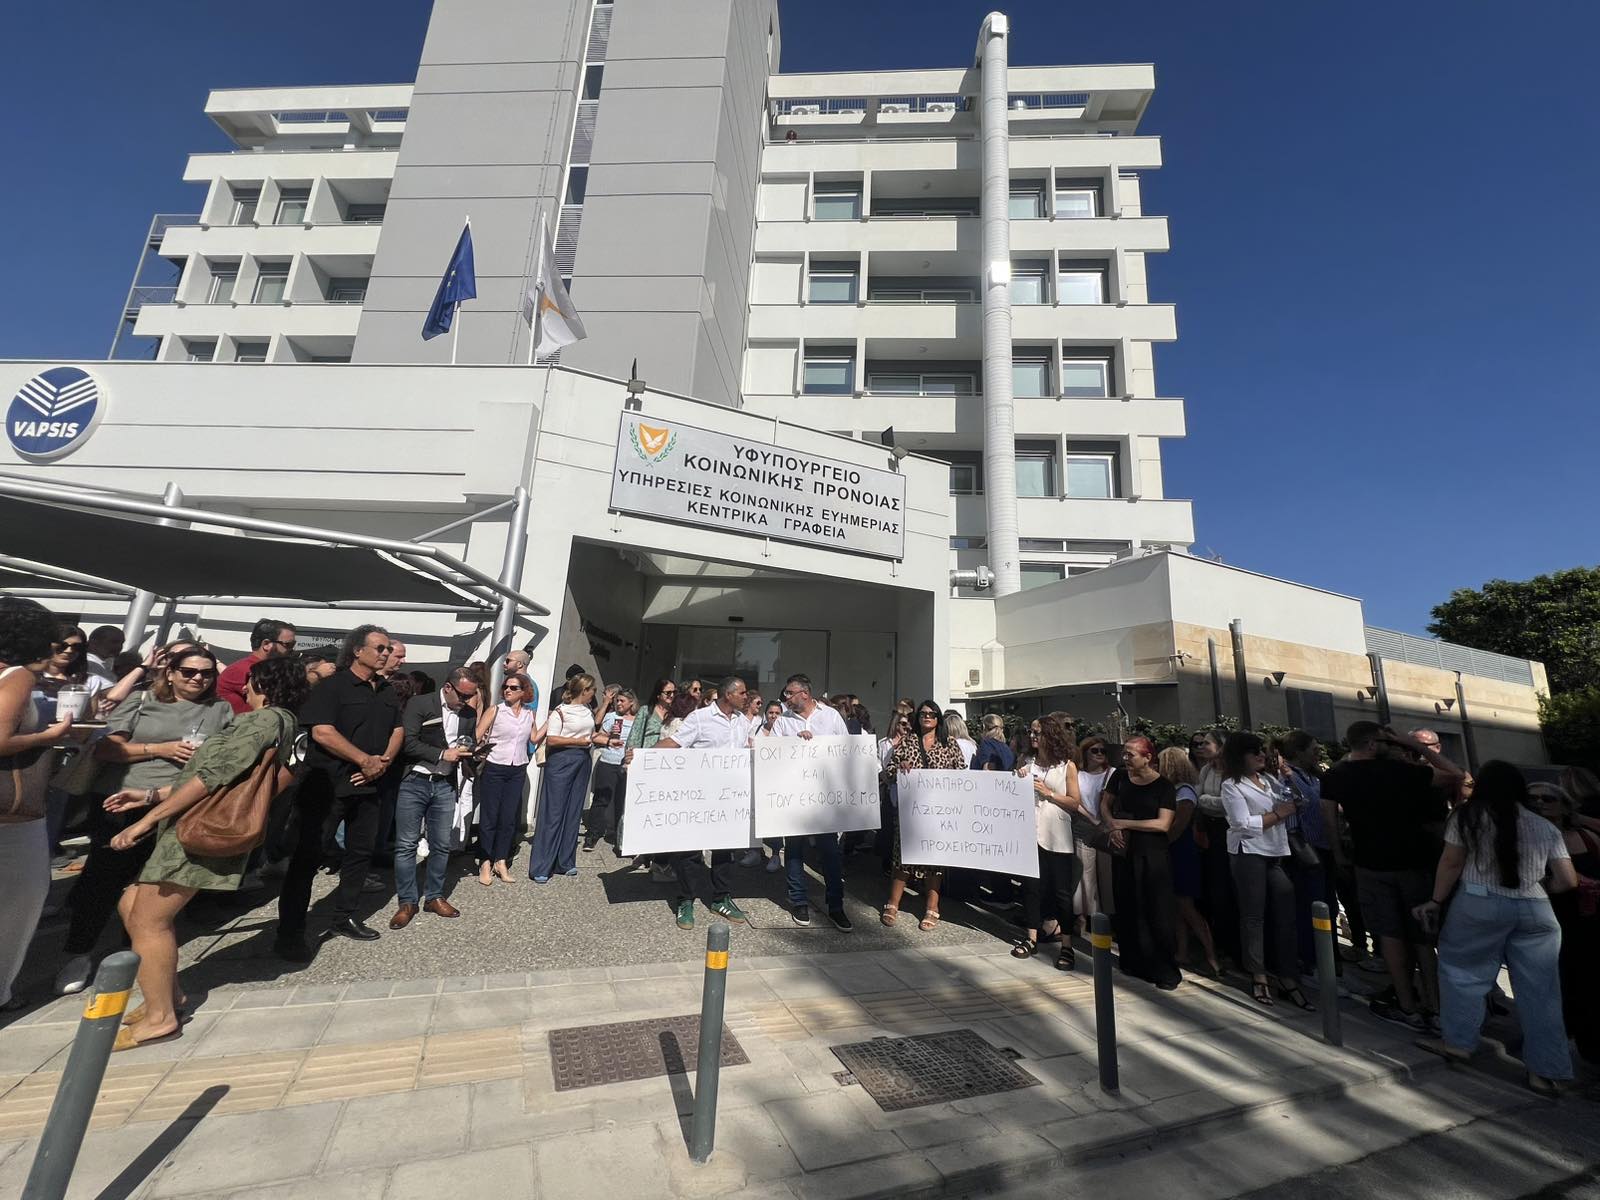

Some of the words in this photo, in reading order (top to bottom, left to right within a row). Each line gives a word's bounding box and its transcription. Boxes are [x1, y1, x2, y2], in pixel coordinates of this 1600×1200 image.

[14, 421, 79, 438] VAPSIS
[733, 444, 861, 485] ΥΦΥΠΟΥΡΓΕΙΟ
[684, 453, 804, 491] ΚΟΙΝΩΝΙΚΗΣ
[813, 480, 900, 512] ΠΡΟΝΟΙΑΣ
[618, 469, 713, 498] ΥΠΗΡΕΣΙΕΣ
[719, 488, 814, 518] ΚΟΙΝΩΝΙΚΗΣ
[821, 508, 900, 535] ΕΥΗΜΕΡΙΑΣ
[687, 500, 768, 526] ΚΕΝΤΡΙΚΑ
[784, 518, 846, 540] ΓΡΑΦΕΙΑ
[643, 751, 686, 771] ΕΔΩ
[760, 744, 782, 761] ΟΧΙ
[790, 744, 819, 760] ΣΤΙΣ
[802, 768, 826, 780] ΚΑΙ
[917, 772, 978, 792] ΑΝΑΠΗΡΟΙ
[994, 778, 1020, 796] ΜΑΣ
[633, 782, 706, 806] ΣΕΒΑΣΜΟΣ
[718, 786, 750, 801] ΣΤΗΝ
[766, 792, 794, 808] ΤΟΝ
[642, 808, 728, 829] ΑΞΙΟΠΡΕΠΕΙΑ
[973, 804, 1026, 821] ΠΟΙΟΤΗΤΑ
[940, 820, 959, 832] ΚΑΙ
[971, 821, 993, 835] ΟΧΙ
